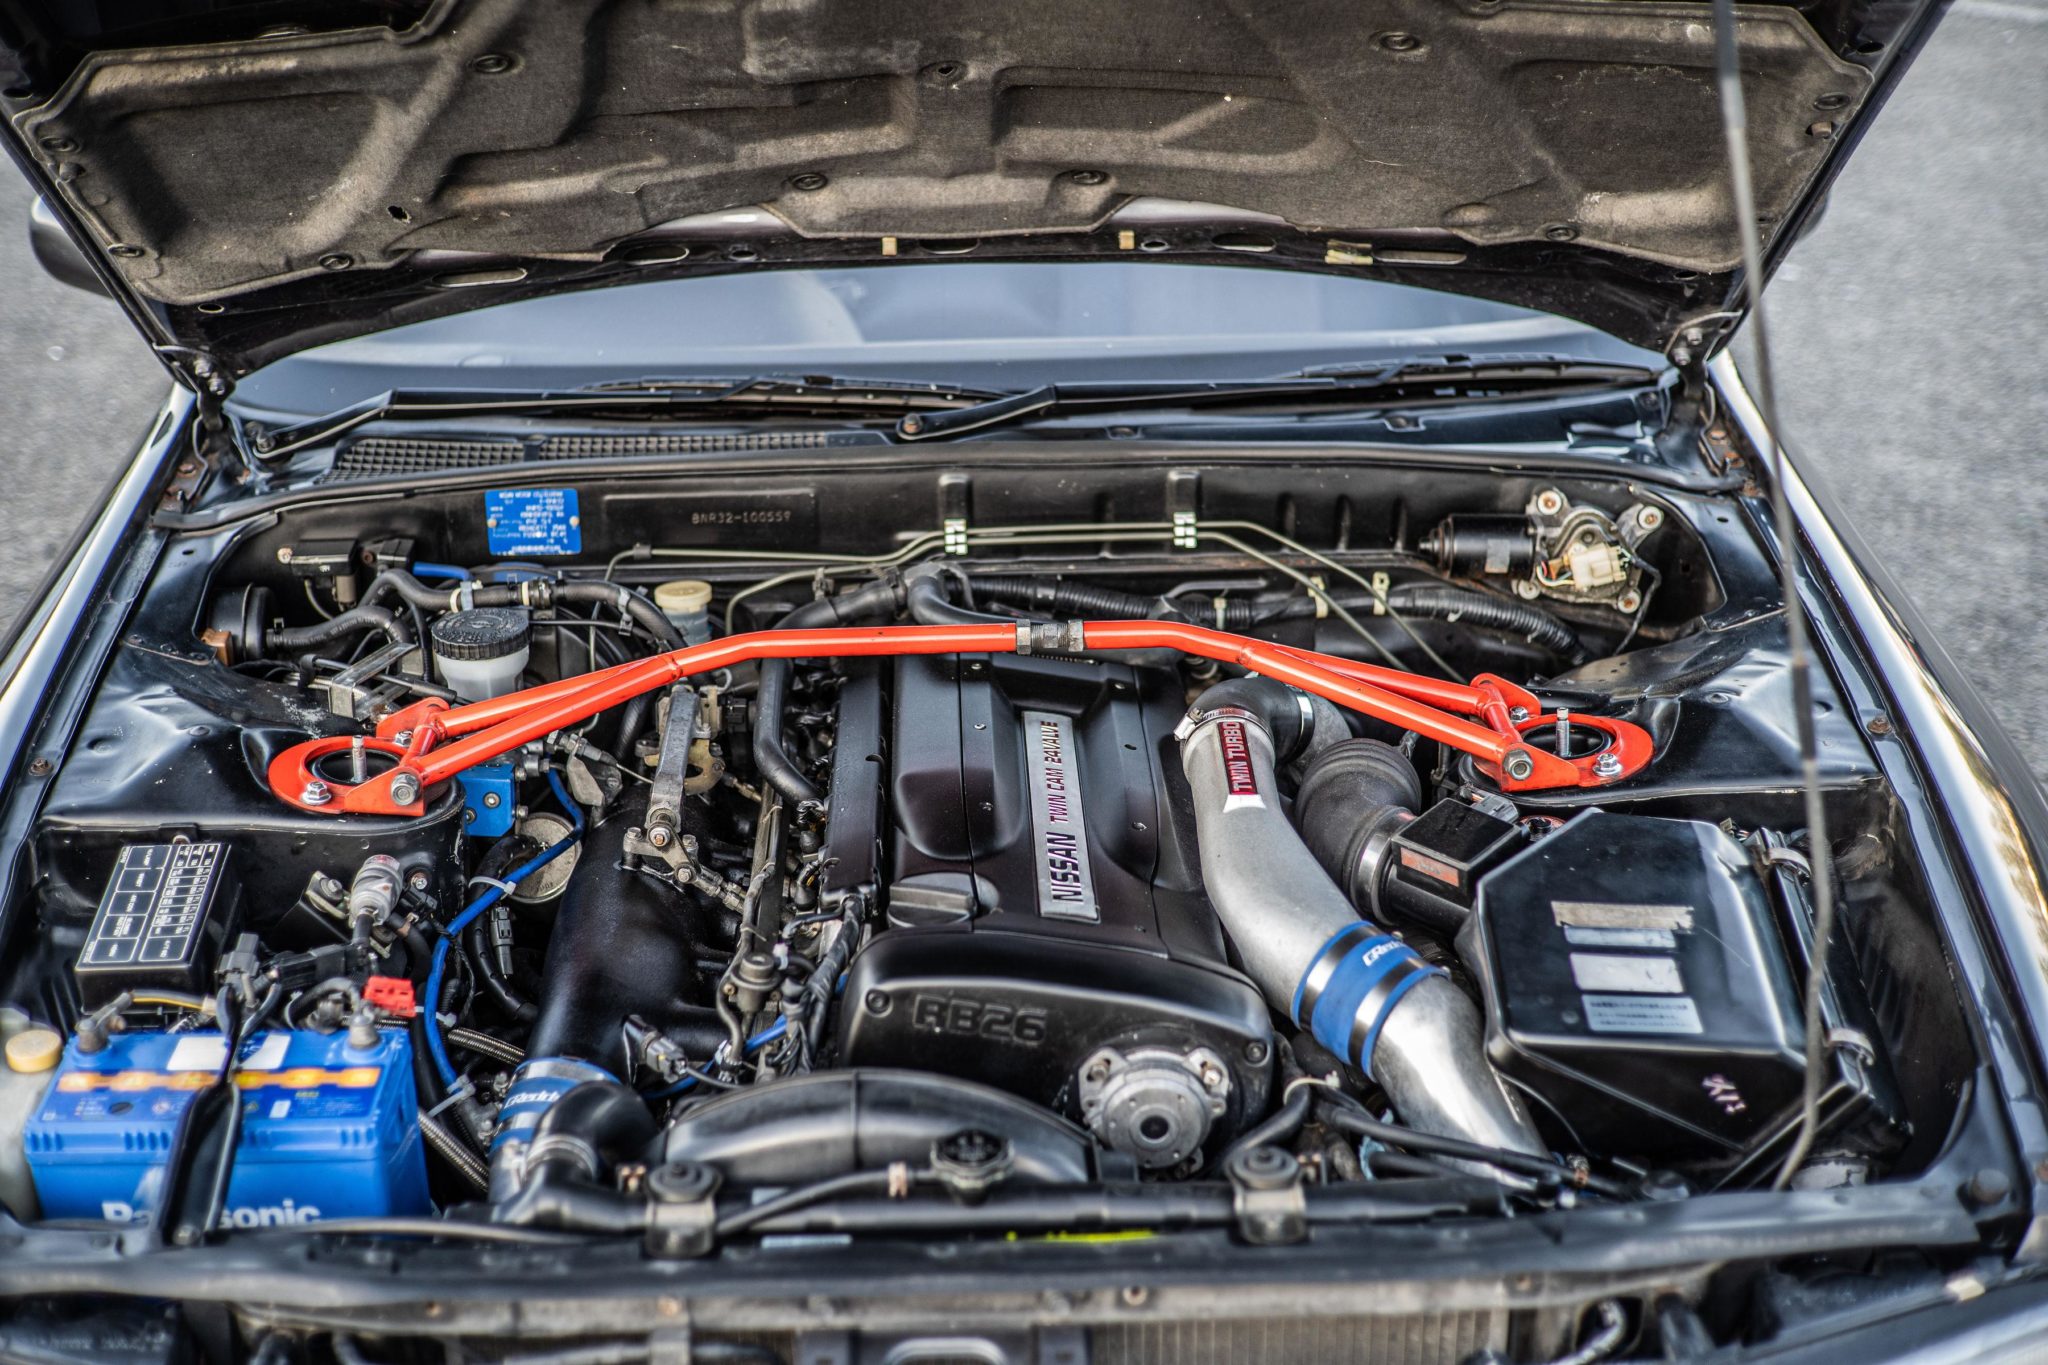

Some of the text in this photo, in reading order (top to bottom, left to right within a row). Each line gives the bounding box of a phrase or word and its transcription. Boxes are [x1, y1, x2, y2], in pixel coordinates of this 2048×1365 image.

[1222, 721, 1246, 759] TURBO
[1230, 760, 1253, 792] TWIN
[1040, 721, 1084, 903] NISSAN TWIN CAM 24VALVE
[912, 994, 1048, 1048] RB26
